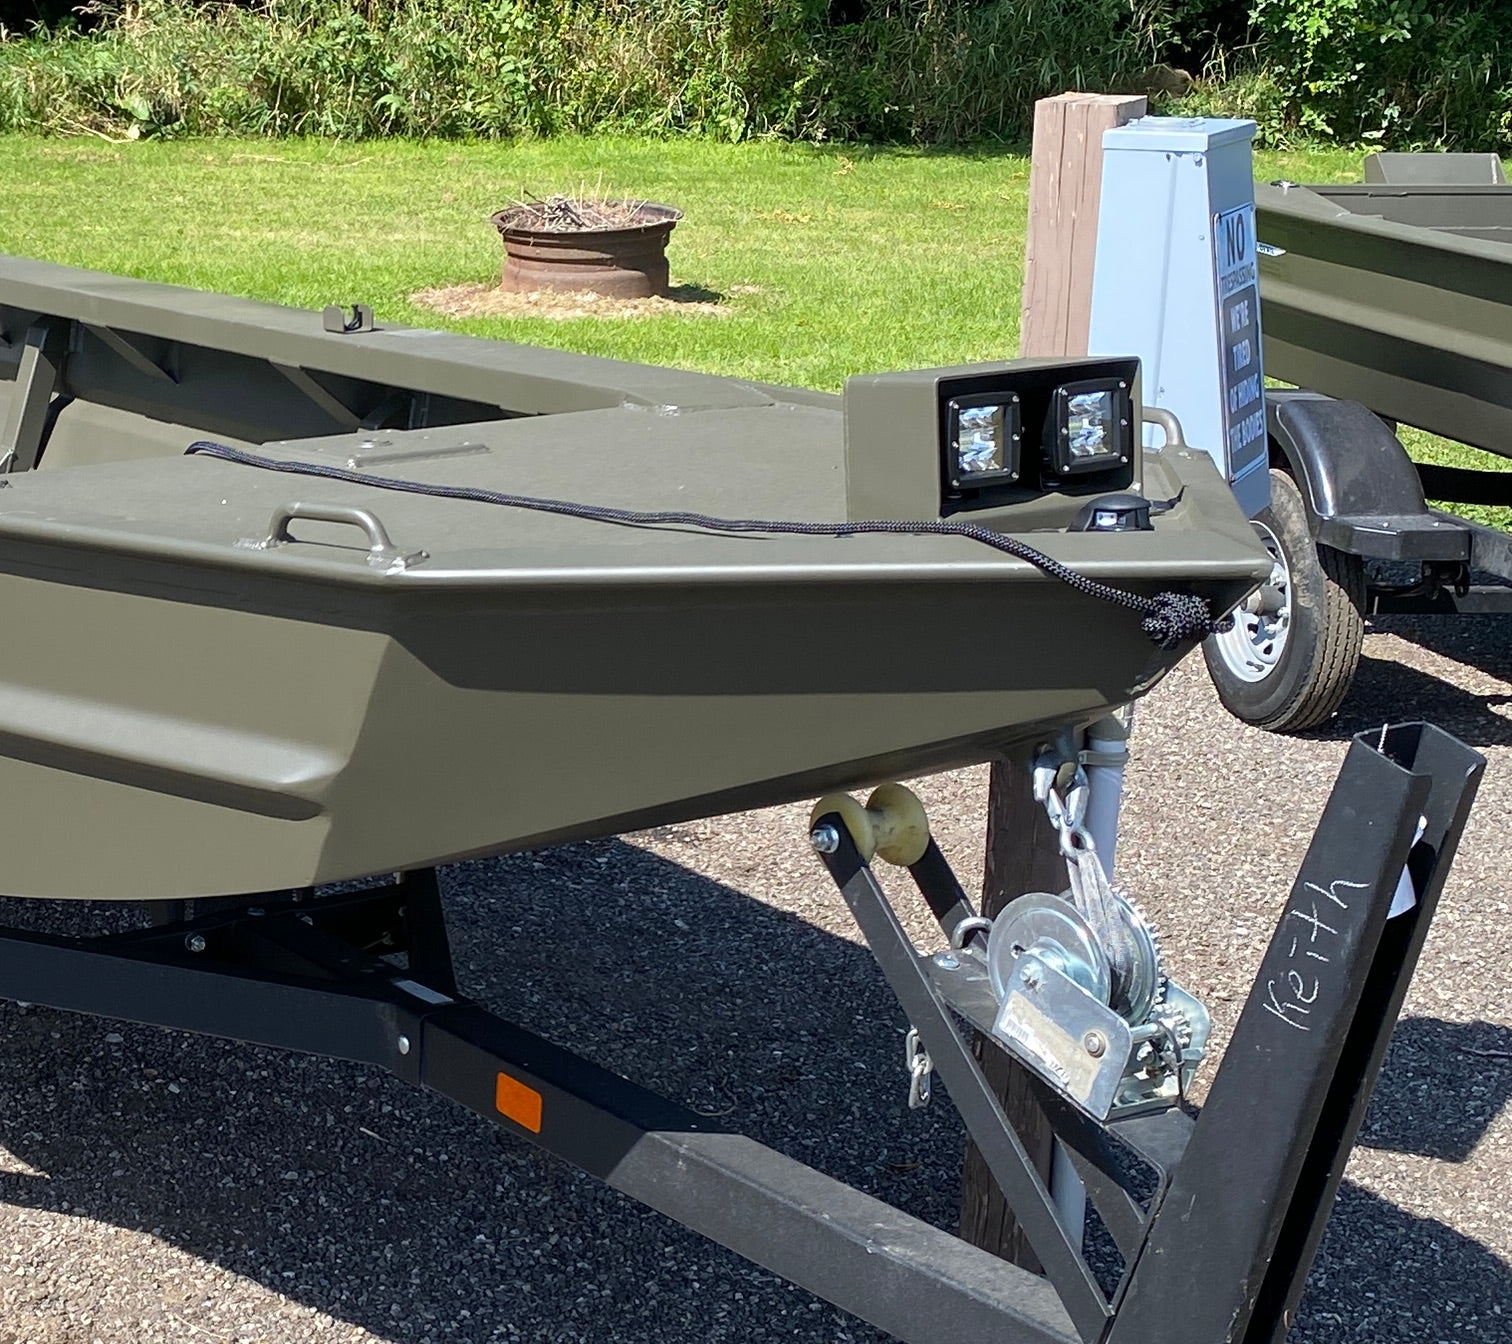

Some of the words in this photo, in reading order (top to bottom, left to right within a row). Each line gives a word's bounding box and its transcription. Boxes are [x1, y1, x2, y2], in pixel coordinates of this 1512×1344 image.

[1226, 213, 1245, 267] NO
[1220, 262, 1256, 296] TRESPASSING
[1232, 338, 1251, 371] TIRED
[1229, 385, 1238, 414] OF
[1237, 372, 1260, 409] HIDING
[1229, 423, 1243, 454] THE
[1241, 408, 1264, 446] BODIES
